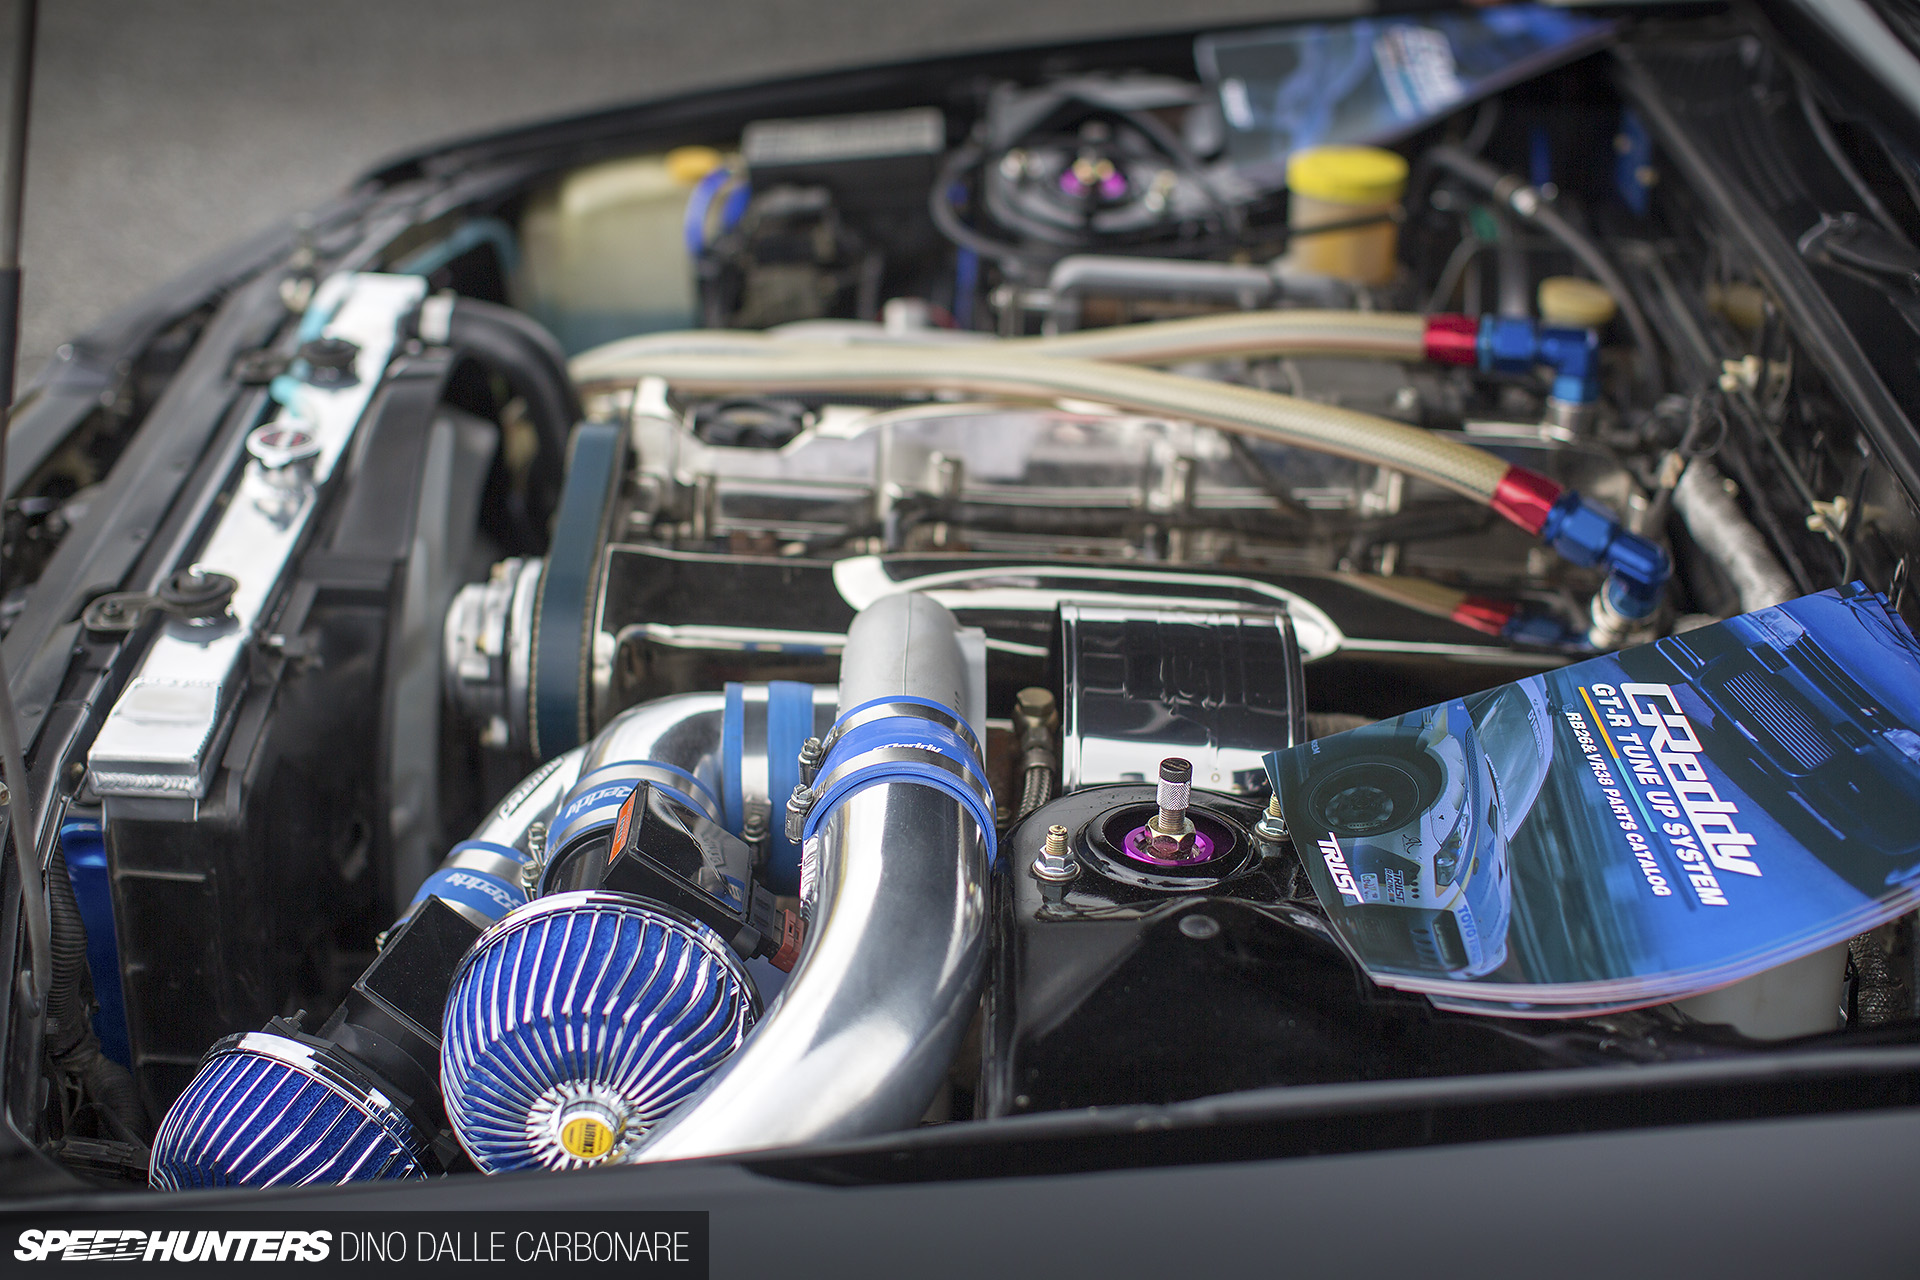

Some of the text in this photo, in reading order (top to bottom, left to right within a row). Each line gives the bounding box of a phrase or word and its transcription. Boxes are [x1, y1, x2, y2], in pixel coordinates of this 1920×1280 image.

[565, 785, 634, 819] Reddy
[1591, 683, 1730, 906] GT-R TUNE UP SYSTEM
[1317, 832, 1365, 904] TRUST
[1602, 788, 1639, 831] PARTS
[1625, 832, 1673, 897] CATALOG
